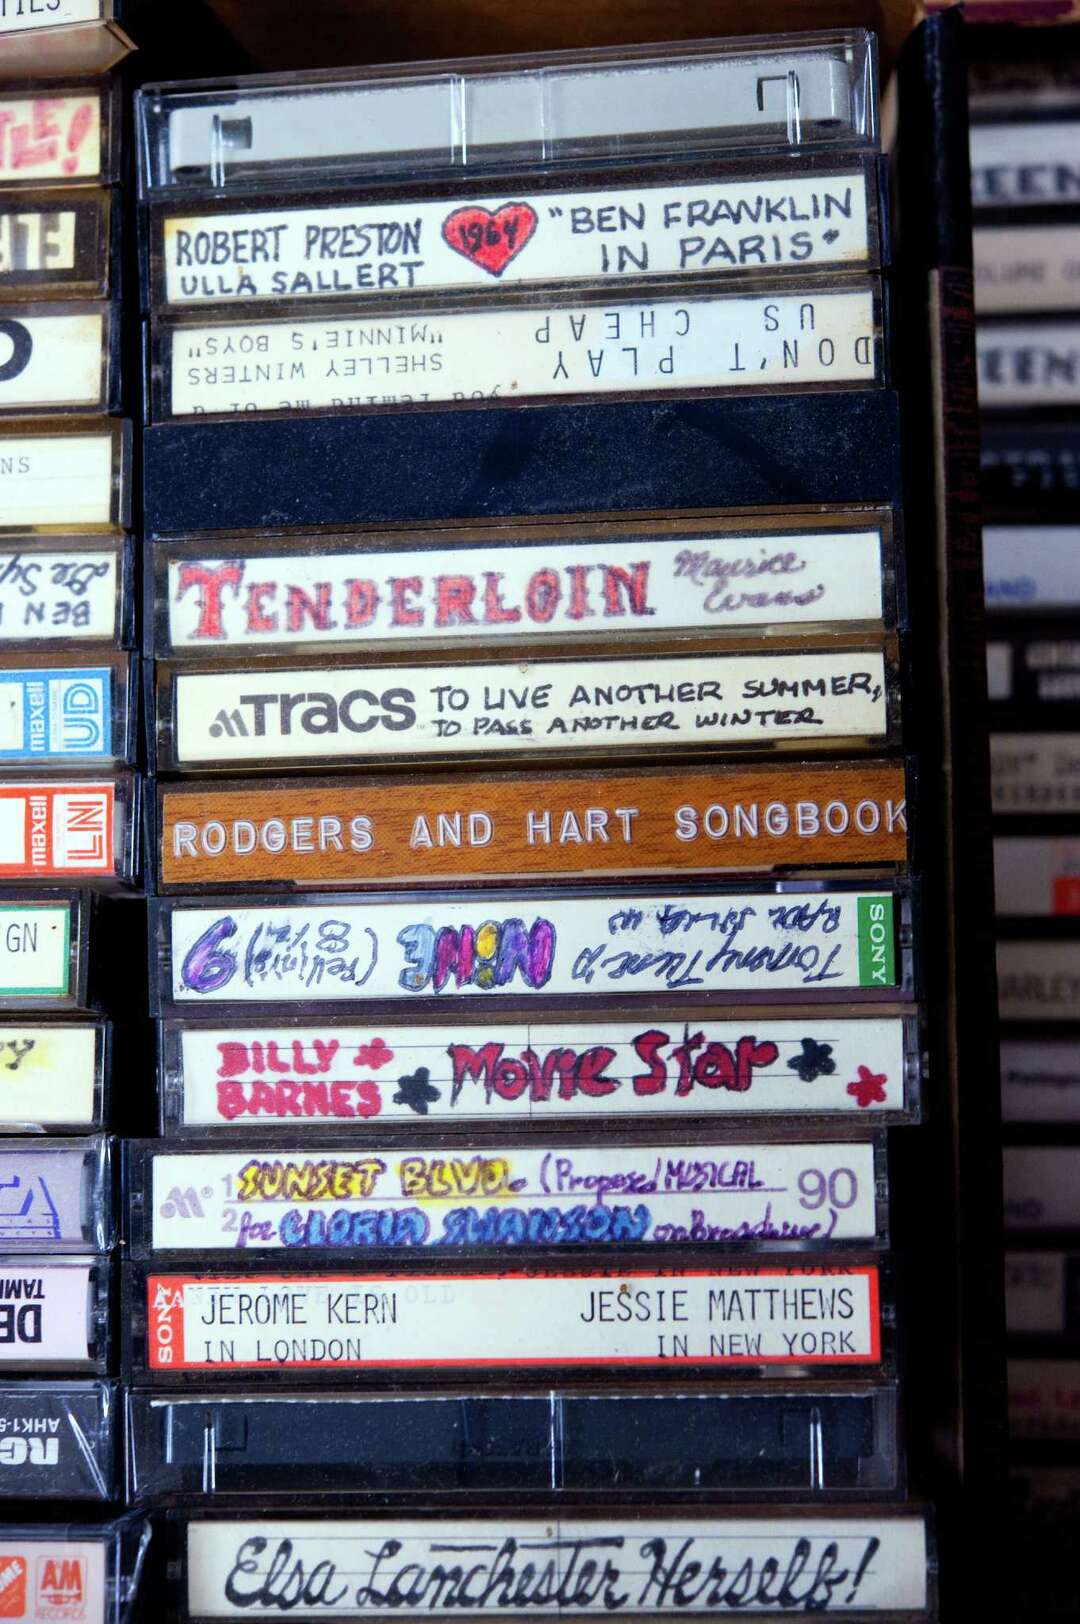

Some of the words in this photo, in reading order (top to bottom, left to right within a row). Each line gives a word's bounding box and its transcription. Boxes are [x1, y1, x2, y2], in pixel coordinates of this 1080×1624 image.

[548, 202, 646, 234] "BEN
[663, 187, 852, 229] FRANKLIN
[175, 224, 288, 267] ROBERT
[304, 217, 423, 260] PRESTON
[458, 214, 521, 250] 1964
[601, 242, 649, 273] IN
[181, 272, 257, 296] ULLA
[271, 261, 425, 294] SALLERT
[291, 322, 443, 351] "MINNIE'S
[535, 309, 690, 343] CHEAP
[764, 303, 816, 332] US
[189, 334, 269, 358] BOYS"
[553, 345, 675, 380] PLAY
[729, 335, 873, 372] DON'T
[189, 362, 305, 386] WINTERS
[326, 353, 443, 378] SHELLEY
[674, 548, 807, 587] Maurice
[24, 599, 90, 628] BEN
[175, 558, 658, 641] TENDERLOIN
[430, 685, 469, 712] TO
[484, 684, 552, 710] LIVE
[569, 680, 723, 707] ANOTHER
[742, 672, 883, 703] SUMMER,
[26, 681, 45, 751] maxell
[63, 682, 99, 748] UD
[431, 718, 461, 738] TO
[473, 716, 533, 737] PASS
[547, 715, 681, 736] ANOTHER
[696, 707, 824, 729] WINTER
[29, 795, 48, 866] maxell
[67, 801, 103, 860] LN
[173, 815, 375, 858] RODGERS
[410, 810, 494, 849] AND
[527, 806, 640, 847] HART
[675, 799, 908, 842] SONGBOOK
[869, 902, 888, 985] SONY
[216, 1038, 340, 1077] BILLY
[446, 1041, 622, 1108] Movie
[631, 1022, 780, 1098] Star
[216, 1078, 382, 1120] BARNES
[238, 1157, 388, 1201] SUNSET
[663, 1158, 766, 1193] MUSICAL
[797, 1167, 858, 1211] 90
[279, 1205, 431, 1248] GLORIA
[434, 1203, 652, 1246] SWANSON
[0, 1278, 45, 1300] TAM
[201, 1292, 306, 1325] JEROME
[328, 1291, 398, 1325] KERN
[580, 1289, 689, 1323] JESSIE
[708, 1287, 855, 1322] MATTHEWS
[204, 1339, 236, 1364] IN
[256, 1338, 362, 1365] LONDON
[657, 1334, 688, 1358] IN
[710, 1332, 763, 1358] NEW
[782, 1330, 857, 1356] YORK
[224, 1536, 348, 1611] Elsa
[356, 1535, 630, 1611] Lanchester
[638, 1536, 881, 1612] Herself!
